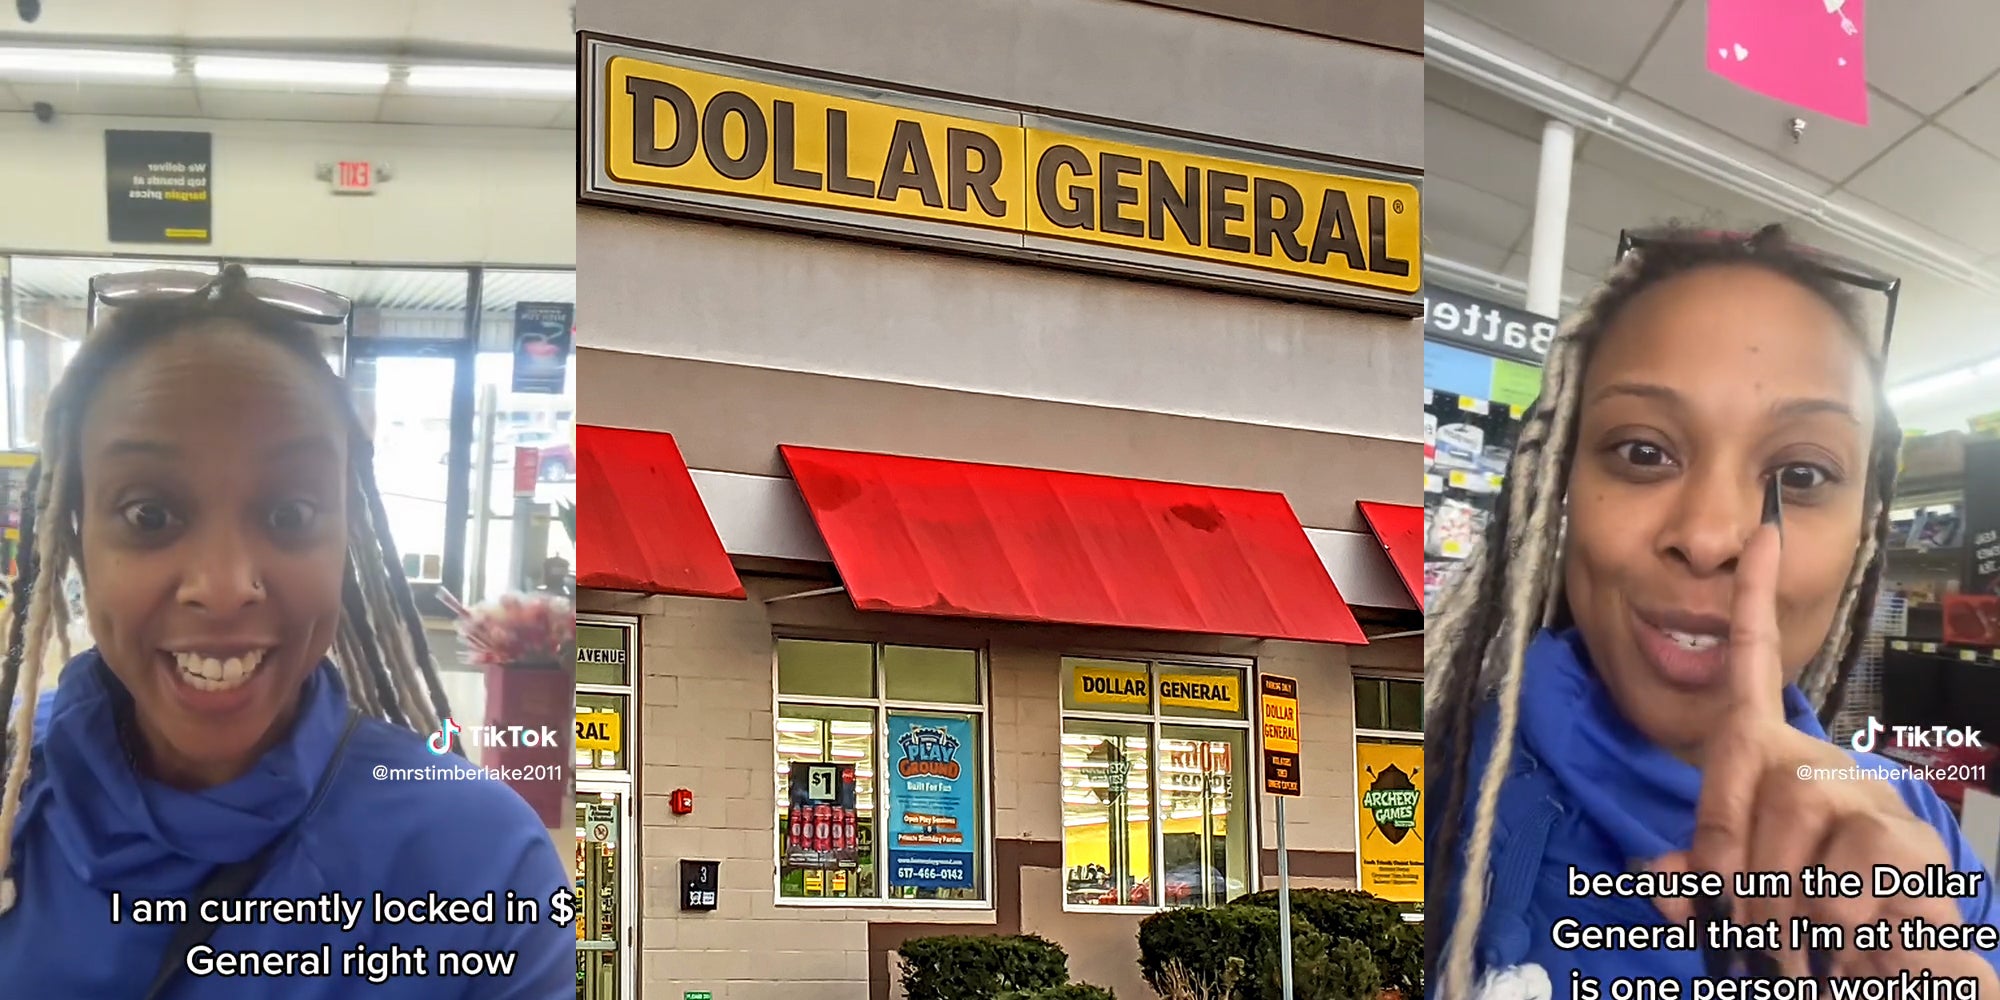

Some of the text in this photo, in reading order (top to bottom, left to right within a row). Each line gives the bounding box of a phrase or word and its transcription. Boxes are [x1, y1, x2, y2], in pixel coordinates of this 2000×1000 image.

[627, 76, 1409, 276] DOLLAR GENERAL
[578, 649, 625, 662] AVENUE
[1083, 676, 1231, 701] DOLLAR GENERAL
[1266, 704, 1294, 720] DOLLAR
[1265, 724, 1297, 740] GENERAL
[908, 744, 954, 763] PLAY
[900, 761, 960, 779] GROUND
[812, 772, 832, 795] $1
[907, 781, 952, 793] Built For Fun
[1364, 790, 1419, 807] ARCHERY
[1376, 806, 1413, 824] GAMES
[701, 866, 706, 883] 3
[898, 867, 963, 880] 617-466-0142
